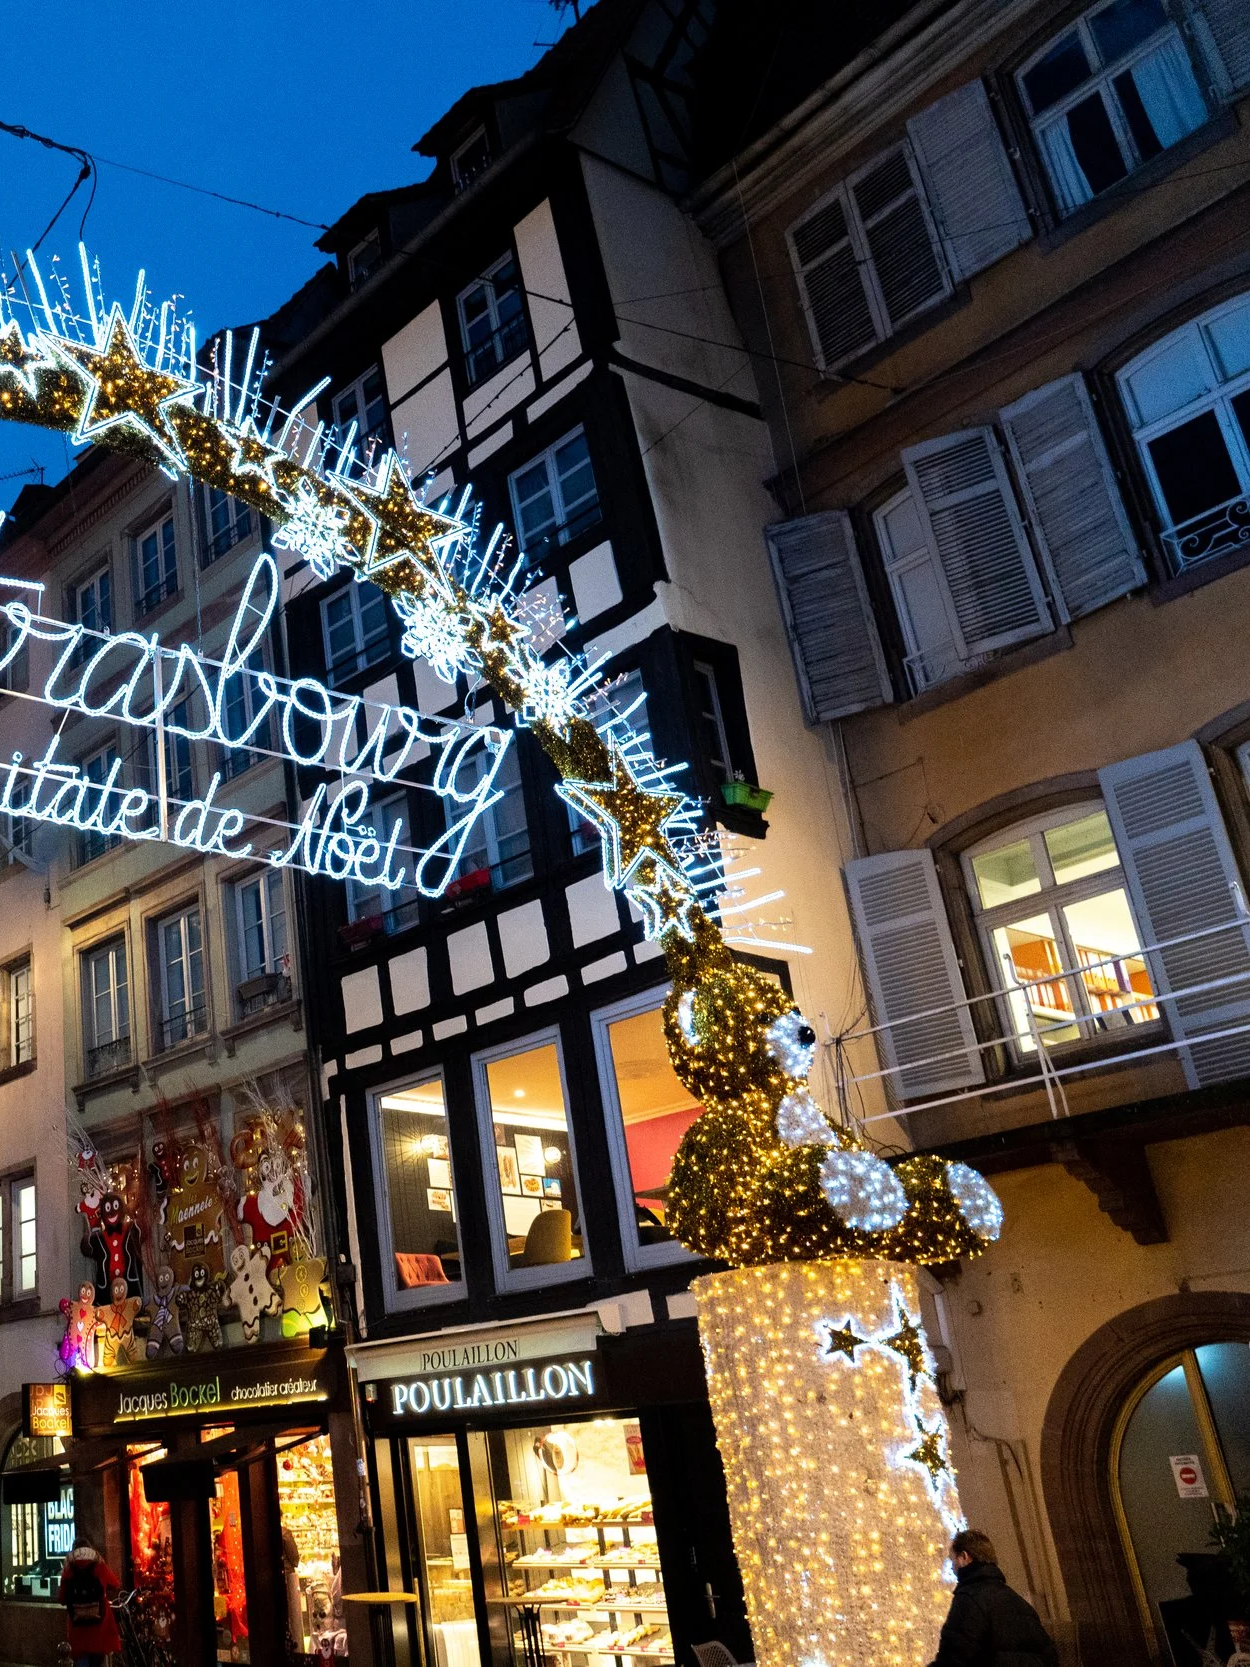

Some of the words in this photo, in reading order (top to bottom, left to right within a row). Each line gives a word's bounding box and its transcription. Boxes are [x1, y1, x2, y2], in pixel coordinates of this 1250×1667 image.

[174, 772, 252, 858] de
[270, 780, 406, 890] Noël
[422, 1339, 518, 1371] POULAILLON
[118, 1392, 168, 1416] Jacques
[170, 1375, 221, 1408] Bockel
[231, 1381, 278, 1401] chocolatier
[279, 1377, 317, 1396] créateur
[391, 1360, 595, 1415] POULAILLON
[32, 1405, 70, 1417] Jacques
[32, 1416, 70, 1430] Bockel
[47, 1487, 74, 1520] BLAC
[48, 1521, 76, 1554] FRIDA
